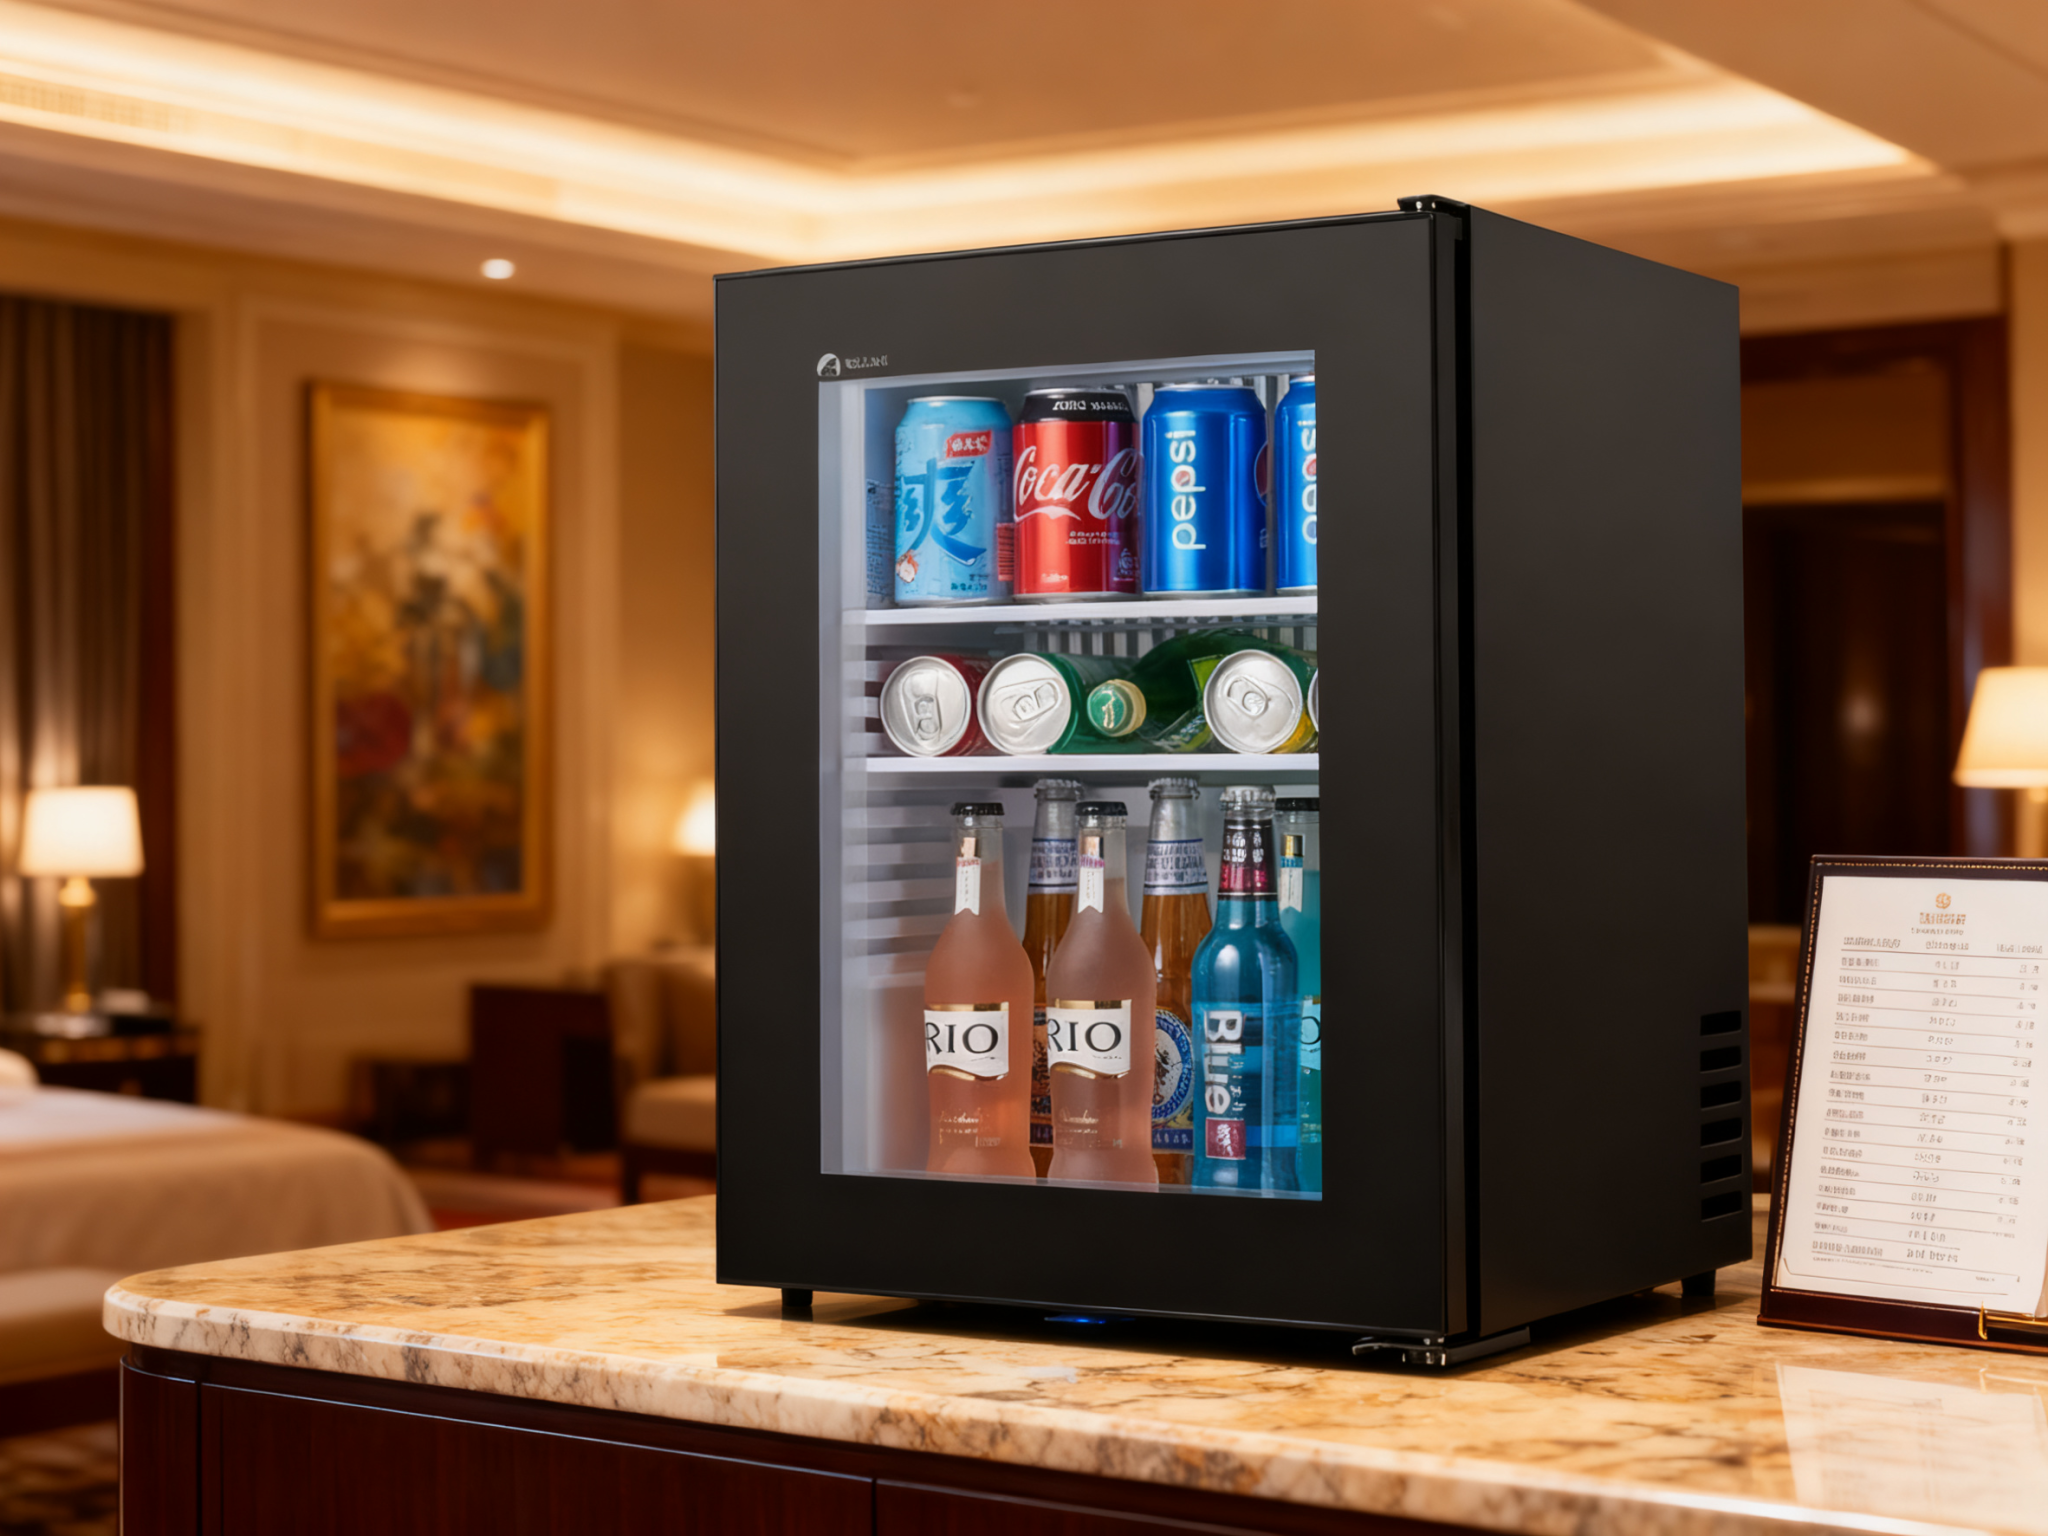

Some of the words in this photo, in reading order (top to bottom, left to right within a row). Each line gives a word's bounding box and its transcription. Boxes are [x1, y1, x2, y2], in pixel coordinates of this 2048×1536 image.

[1165, 430, 1207, 549] pepsi
[925, 1021, 999, 1055] RIO
[1047, 1018, 1122, 1053] RIO
